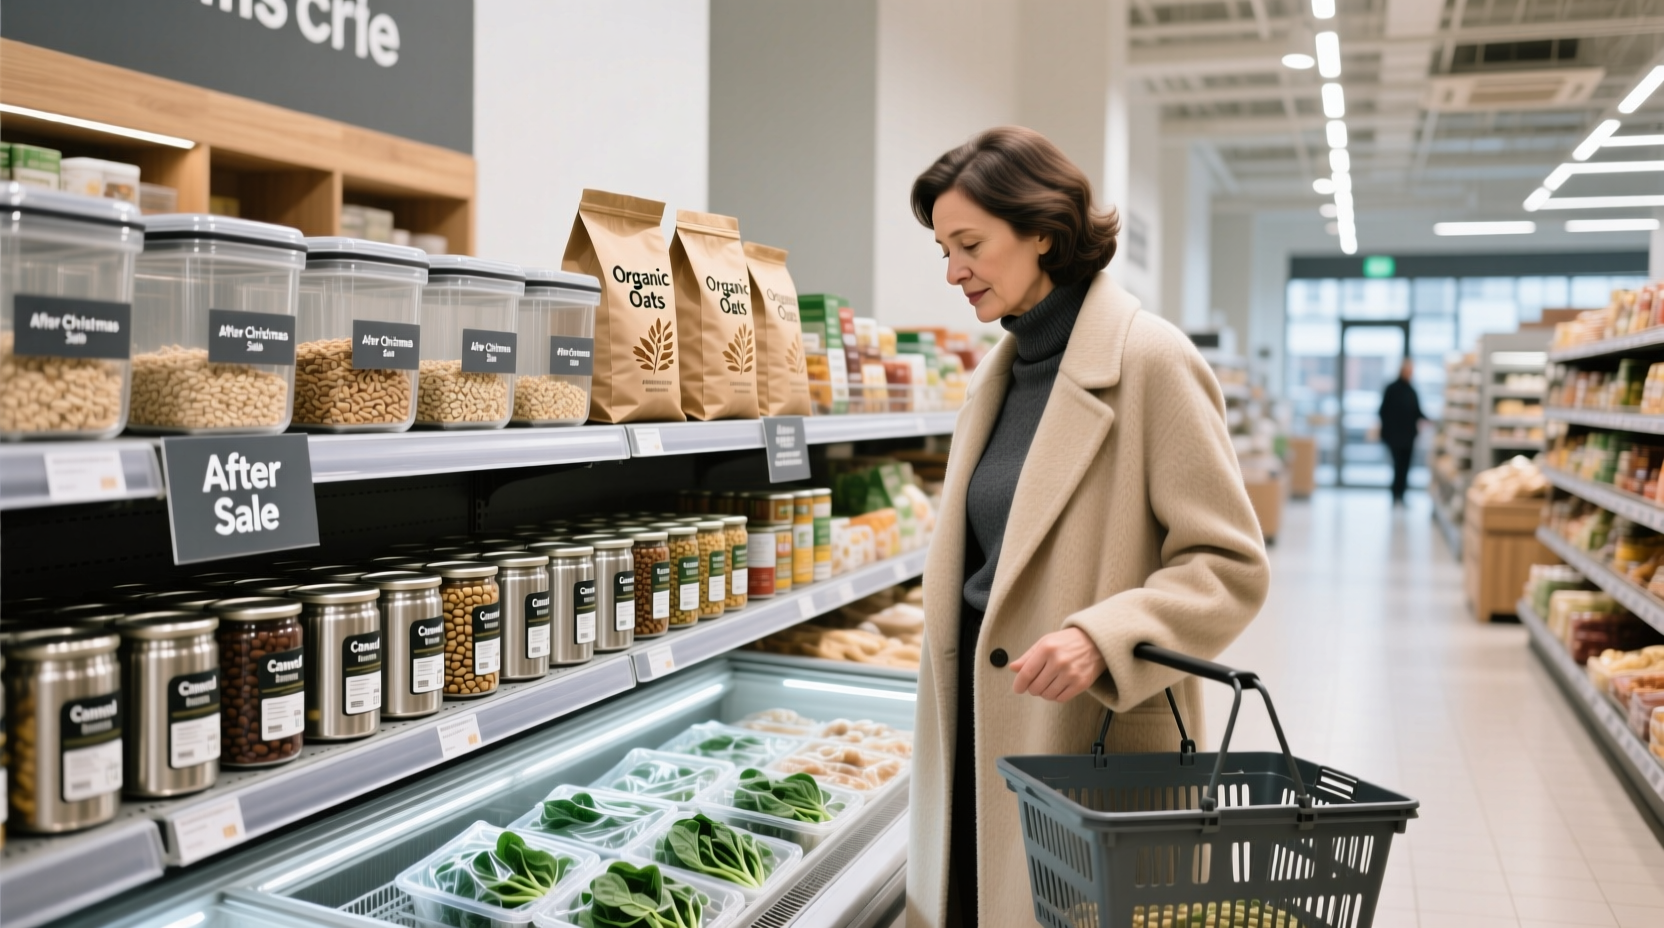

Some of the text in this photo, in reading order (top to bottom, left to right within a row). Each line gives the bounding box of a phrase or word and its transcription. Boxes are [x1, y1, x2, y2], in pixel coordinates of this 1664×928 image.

[612, 265, 670, 290] Organic
[629, 290, 666, 310] Oats
[202, 452, 282, 493] After
[214, 494, 280, 536] Sale
